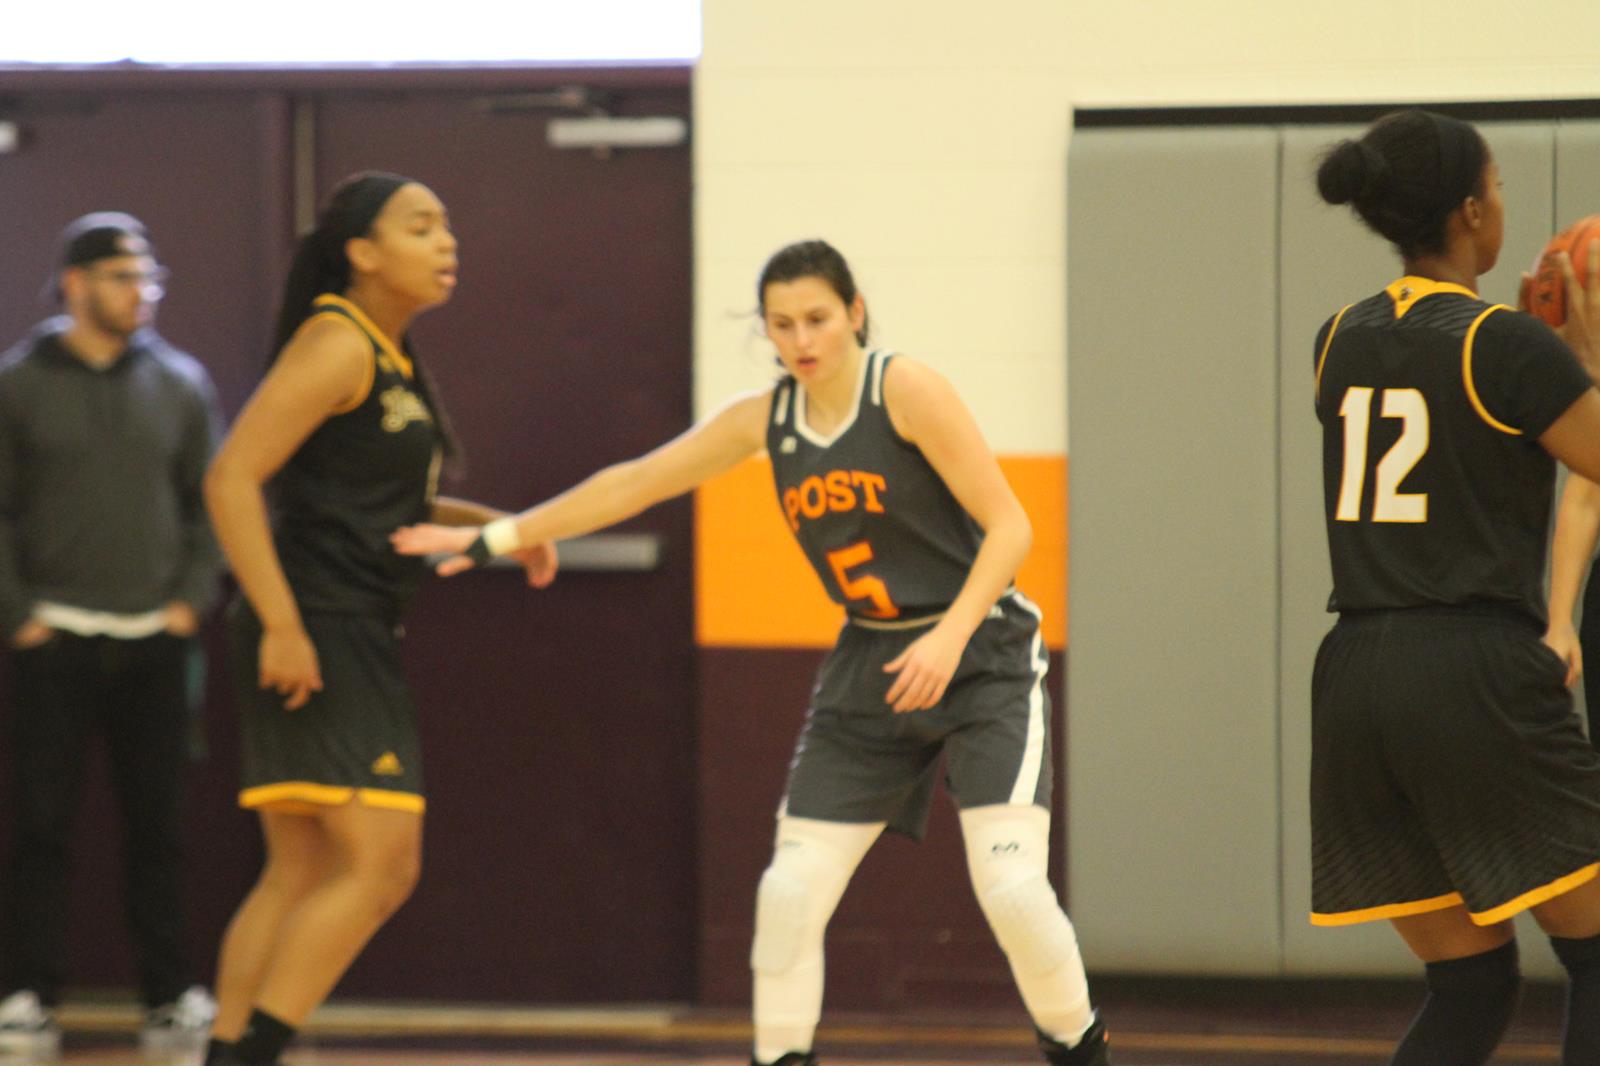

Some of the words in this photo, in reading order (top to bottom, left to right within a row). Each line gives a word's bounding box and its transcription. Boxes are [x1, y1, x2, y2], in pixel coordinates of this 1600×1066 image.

[1336, 386, 1430, 522] 12
[783, 470, 887, 533] POST
[826, 541, 899, 618] 5
